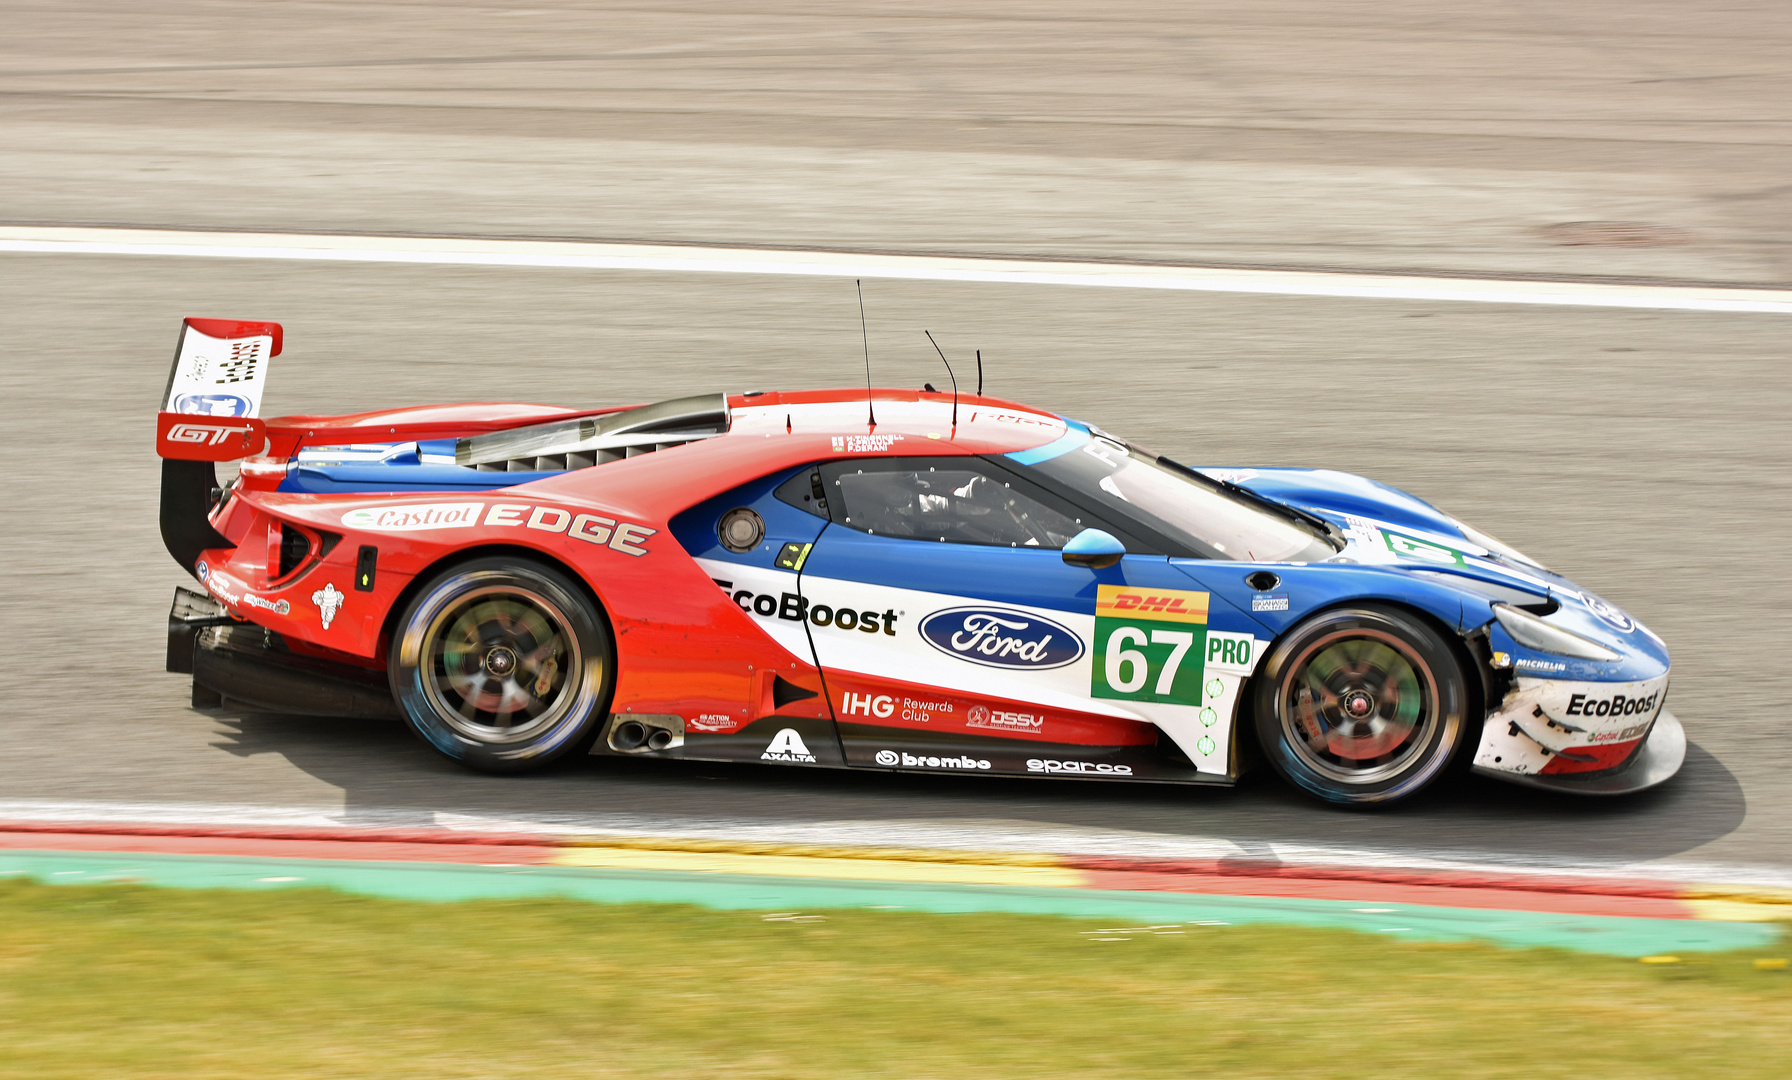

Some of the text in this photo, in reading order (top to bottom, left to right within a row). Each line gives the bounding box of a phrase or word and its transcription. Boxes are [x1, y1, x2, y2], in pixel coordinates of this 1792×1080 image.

[376, 503, 658, 558] Castrol EDGE
[1115, 594, 1190, 614] DHL
[951, 613, 1053, 663] Ford
[1104, 626, 1194, 695] 67
[1207, 637, 1250, 665] PRO
[1516, 659, 1566, 671] MICHELIN
[842, 692, 953, 718] IHG Rewards
[1566, 690, 1658, 717] EcoBoost
[901, 709, 930, 723] Club
[991, 711, 1044, 728] DSSV
[761, 752, 816, 764] AXALTA
[902, 752, 992, 769] brembo
[1026, 758, 1134, 776] sparco
